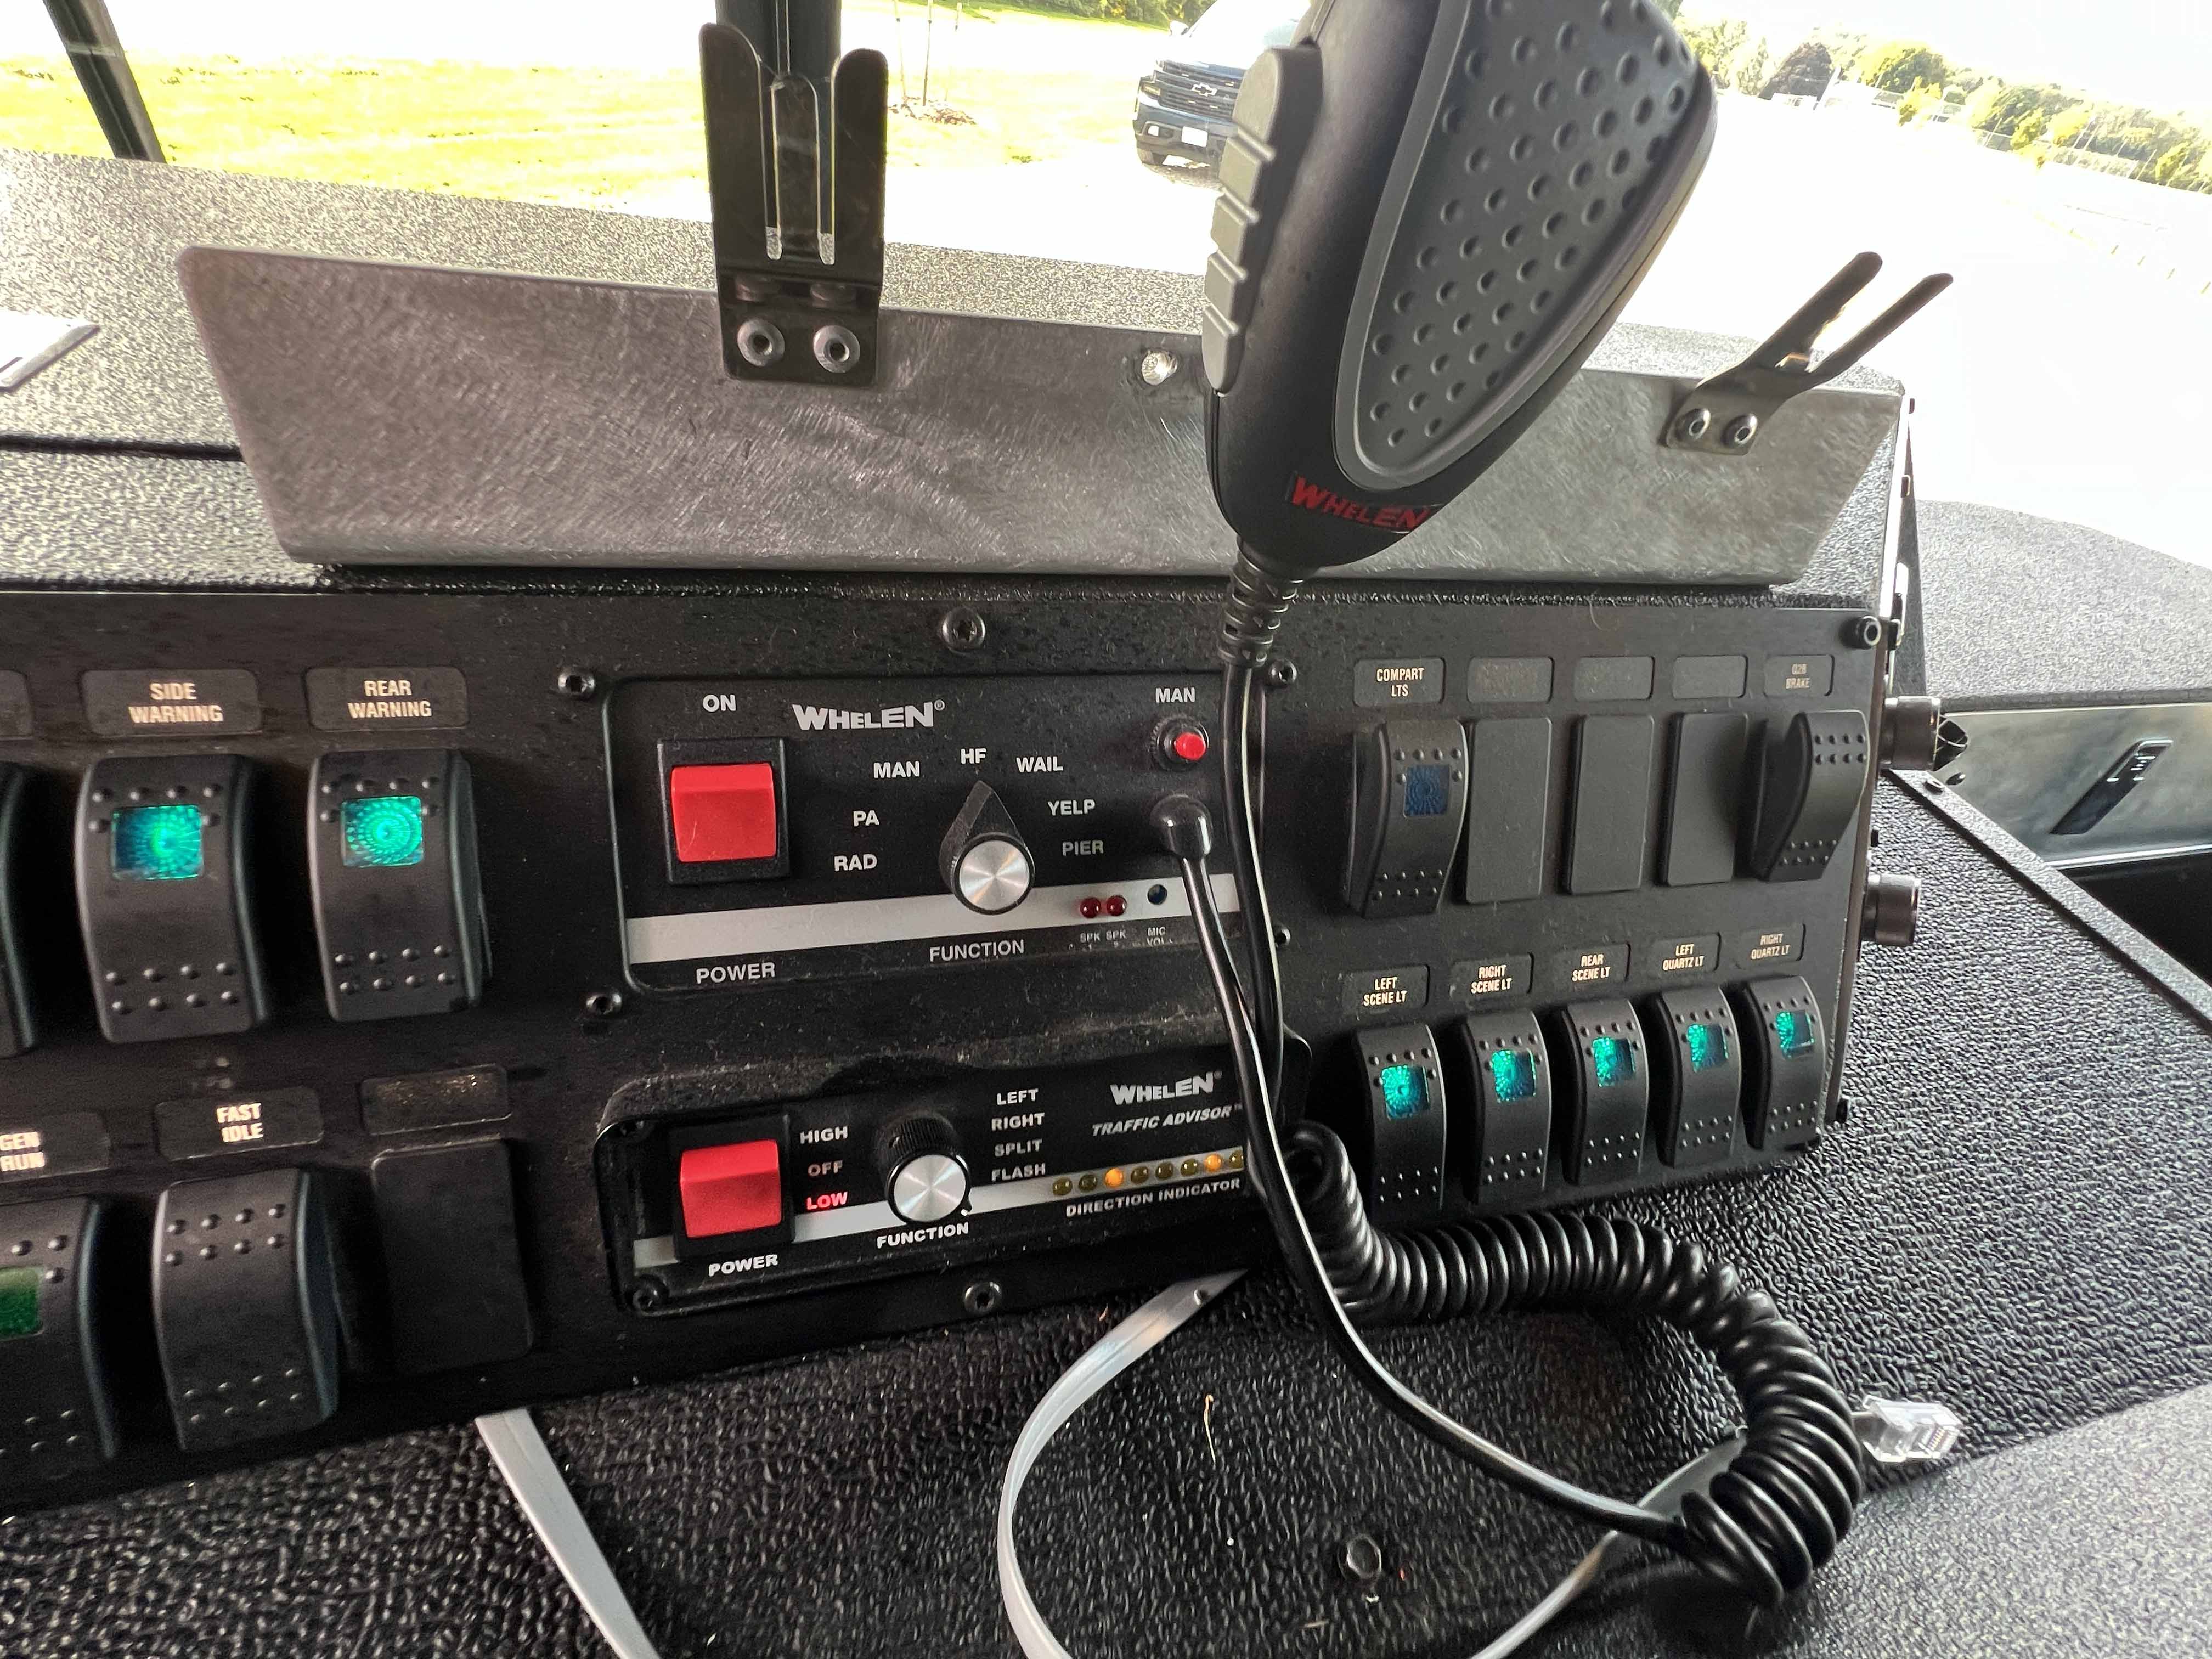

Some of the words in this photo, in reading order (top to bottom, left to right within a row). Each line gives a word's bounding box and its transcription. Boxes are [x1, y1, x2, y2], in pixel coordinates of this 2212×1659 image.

[1293, 476, 1430, 531] WHELEN
[1376, 667, 1425, 681] COMPART
[150, 682, 197, 701] SIDE
[364, 680, 412, 697] REAR
[1155, 687, 1195, 703] MAN
[1391, 684, 1409, 697] LTS
[347, 700, 432, 719] WARNING
[702, 694, 736, 712] ON
[128, 704, 223, 724] WARNING
[961, 748, 986, 764] HF
[1016, 756, 1064, 773] WAIL
[873, 760, 920, 778] MAN
[1048, 799, 1096, 816] YELP
[853, 810, 880, 827] PA
[1062, 840, 1104, 856] PIER
[834, 854, 877, 872] RAD
[1148, 926, 1165, 936] MIC
[1760, 933, 1783, 945] RIGHT
[929, 939, 1024, 963] FUNCTION
[1675, 944, 1695, 956] LEFT
[1751, 946, 1780, 959] QUARTZ
[1781, 945, 1790, 955] LT
[1581, 954, 1604, 967] REAR
[1662, 957, 1694, 970] QUARTZ
[1695, 956, 1705, 966] LT
[696, 962, 775, 984] POWER
[1479, 964, 1506, 979] RIGHT
[1572, 968, 1599, 981] SCENE
[1600, 967, 1611, 978] LT
[1375, 977, 1397, 990] LEFT
[1471, 979, 1500, 994] SCENE
[1502, 978, 1512, 990] LT
[1363, 991, 1394, 1006] SCENE
[1396, 990, 1407, 1002] LT
[997, 1088, 1039, 1105] LEFT
[216, 1103, 262, 1124] FAST
[991, 1112, 1045, 1131] RIGHT
[222, 1121, 263, 1142] IDLE
[1092, 1115, 1160, 1136] TRAFFIC
[800, 1126, 848, 1144] HIGH
[995, 1139, 1042, 1156] SPLIT
[0, 1152, 45, 1172] RUN
[808, 1160, 843, 1176] OFF
[991, 1163, 1046, 1182] FLASH
[806, 1191, 848, 1210] LOW
[1065, 1192, 1153, 1217] DIRECTION
[1158, 1178, 1240, 1202] INDICATOR
[877, 1222, 969, 1249] FUNCTION
[708, 1254, 778, 1277] POWER
